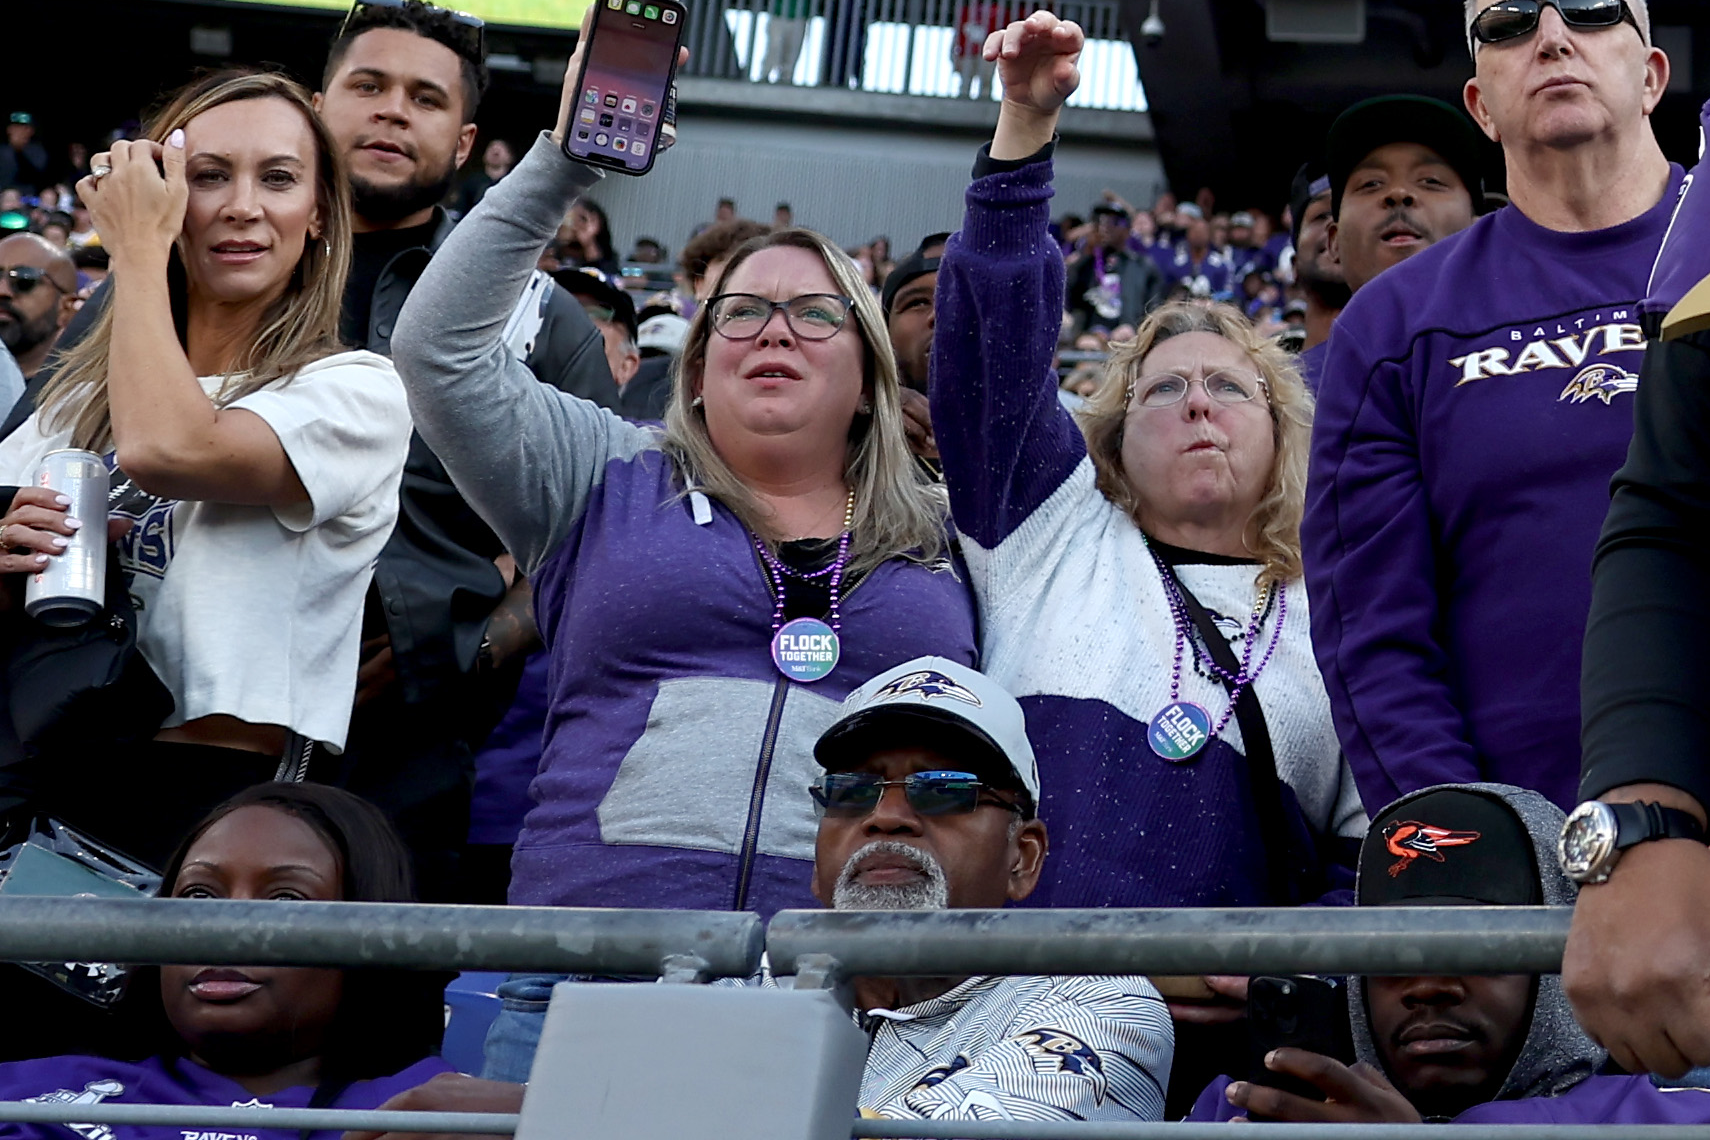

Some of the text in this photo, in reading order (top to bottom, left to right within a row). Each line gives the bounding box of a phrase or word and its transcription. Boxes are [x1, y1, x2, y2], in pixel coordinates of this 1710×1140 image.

[1511, 310, 1628, 341] BALTIM
[1447, 323, 1649, 387] RAVE
[780, 634, 833, 651] FLOCK
[780, 651, 833, 662] TOGETHER
[1156, 714, 1193, 754] TOGETHER
[1165, 704, 1206, 747] FLOCK
